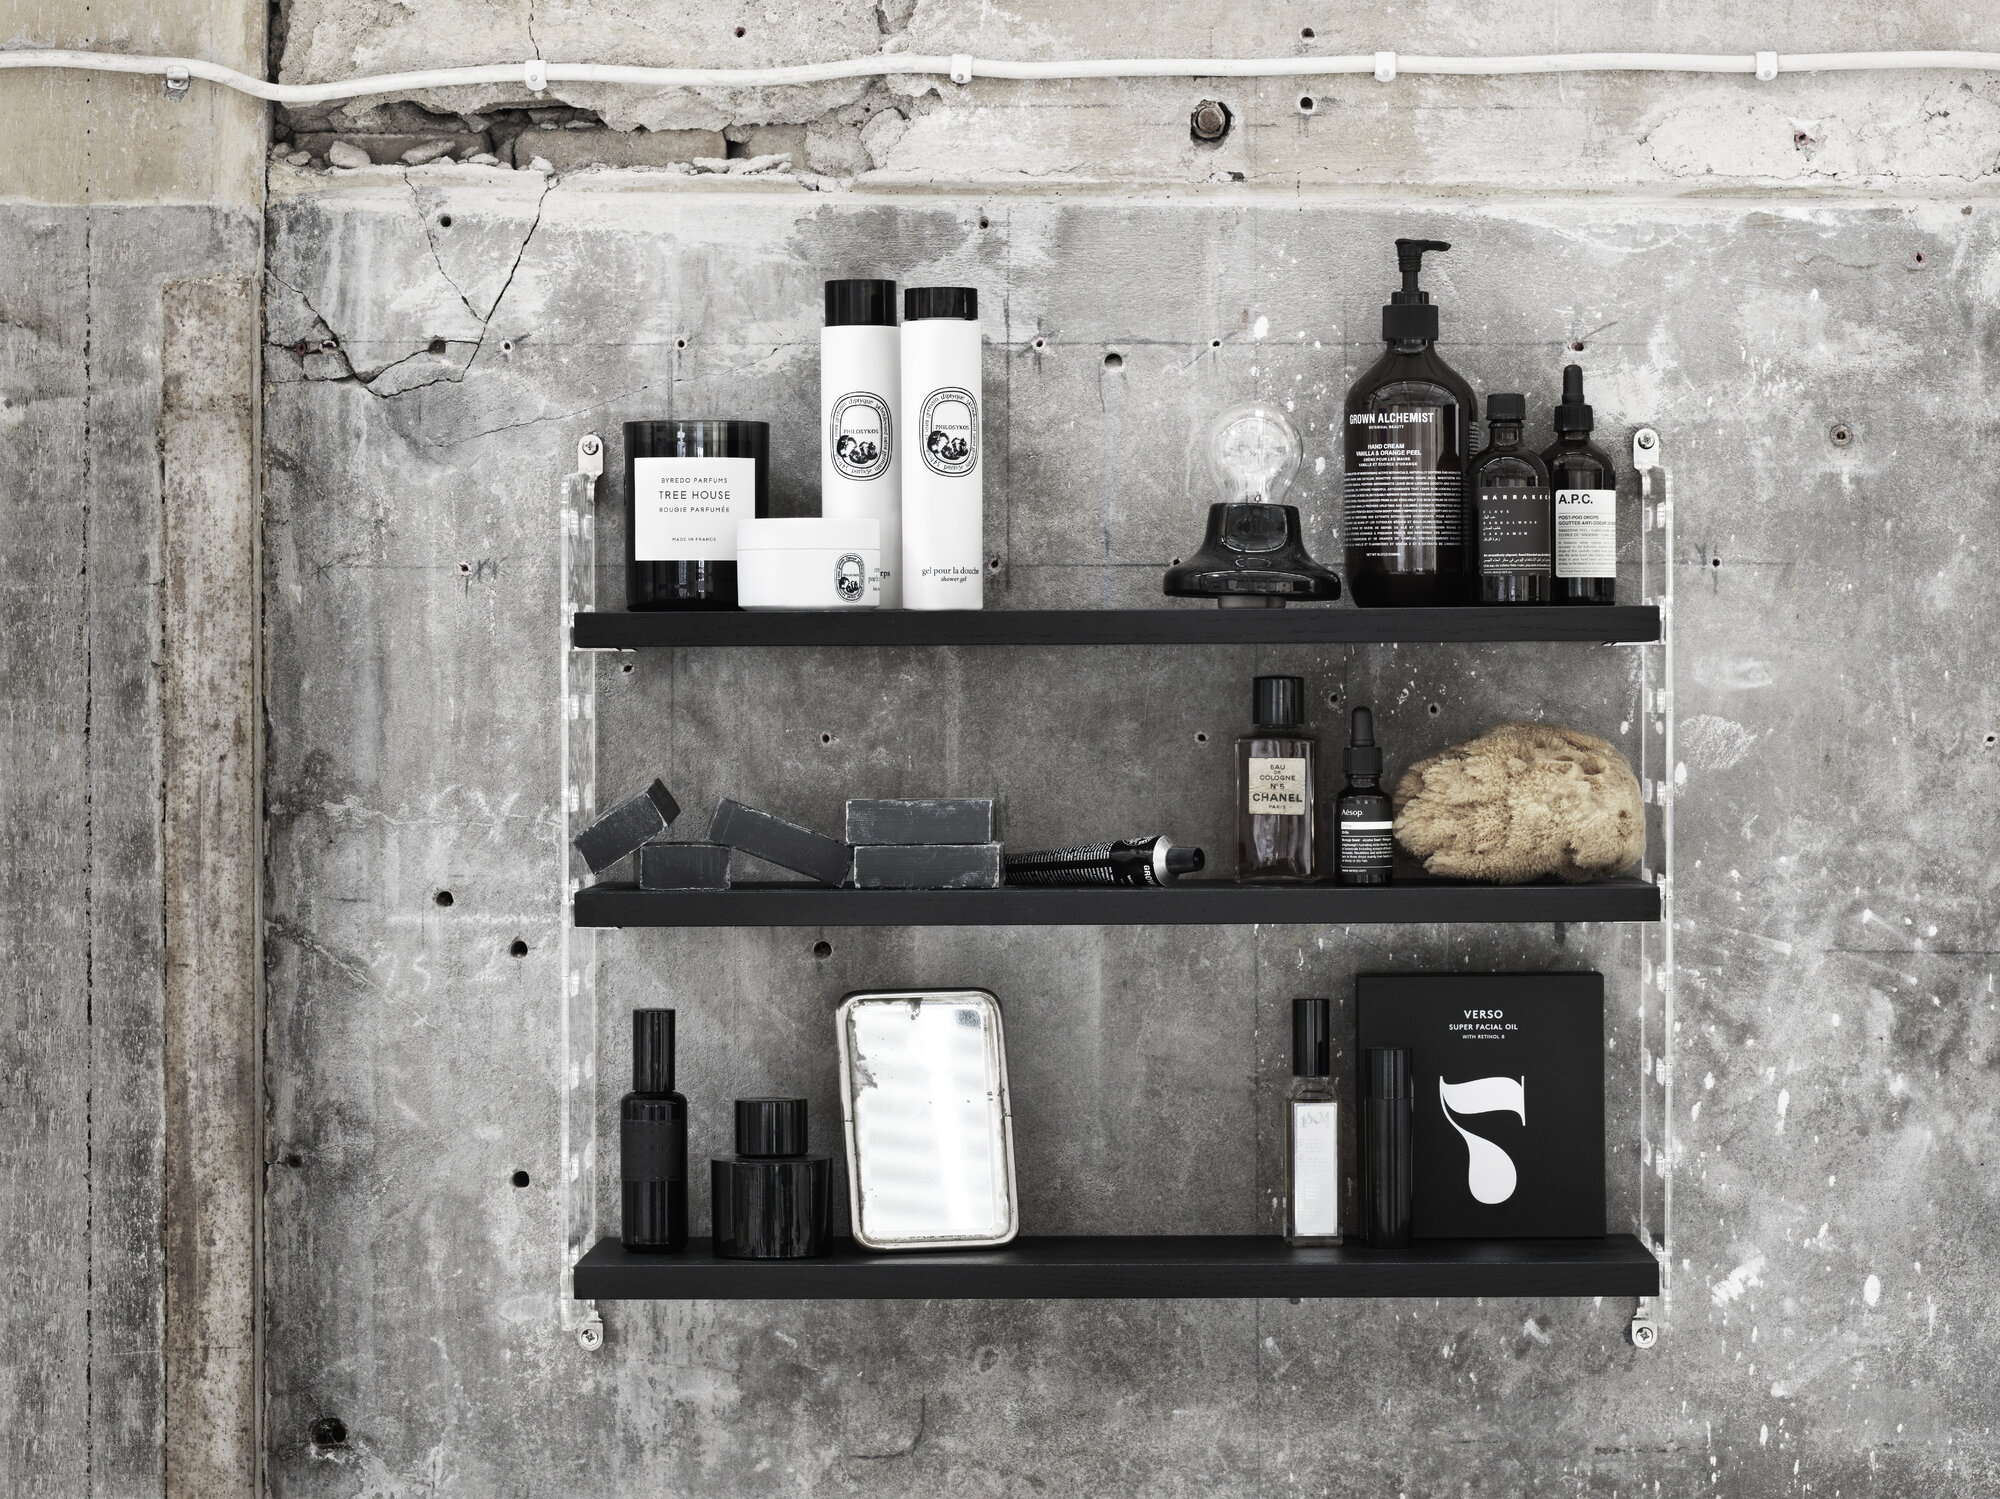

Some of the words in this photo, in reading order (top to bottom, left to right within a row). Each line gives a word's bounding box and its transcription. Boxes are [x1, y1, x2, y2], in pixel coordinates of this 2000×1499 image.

[1350, 414, 1375, 424] GROWN
[1378, 412, 1434, 423] ALCHEMIST
[659, 490, 687, 500] TREE
[692, 490, 730, 500] HOUSE
[1558, 494, 1593, 504] A.P.C.
[922, 567, 932, 576] gel
[1253, 793, 1302, 802] CHANEL
[1464, 1010, 1503, 1019] VERSO
